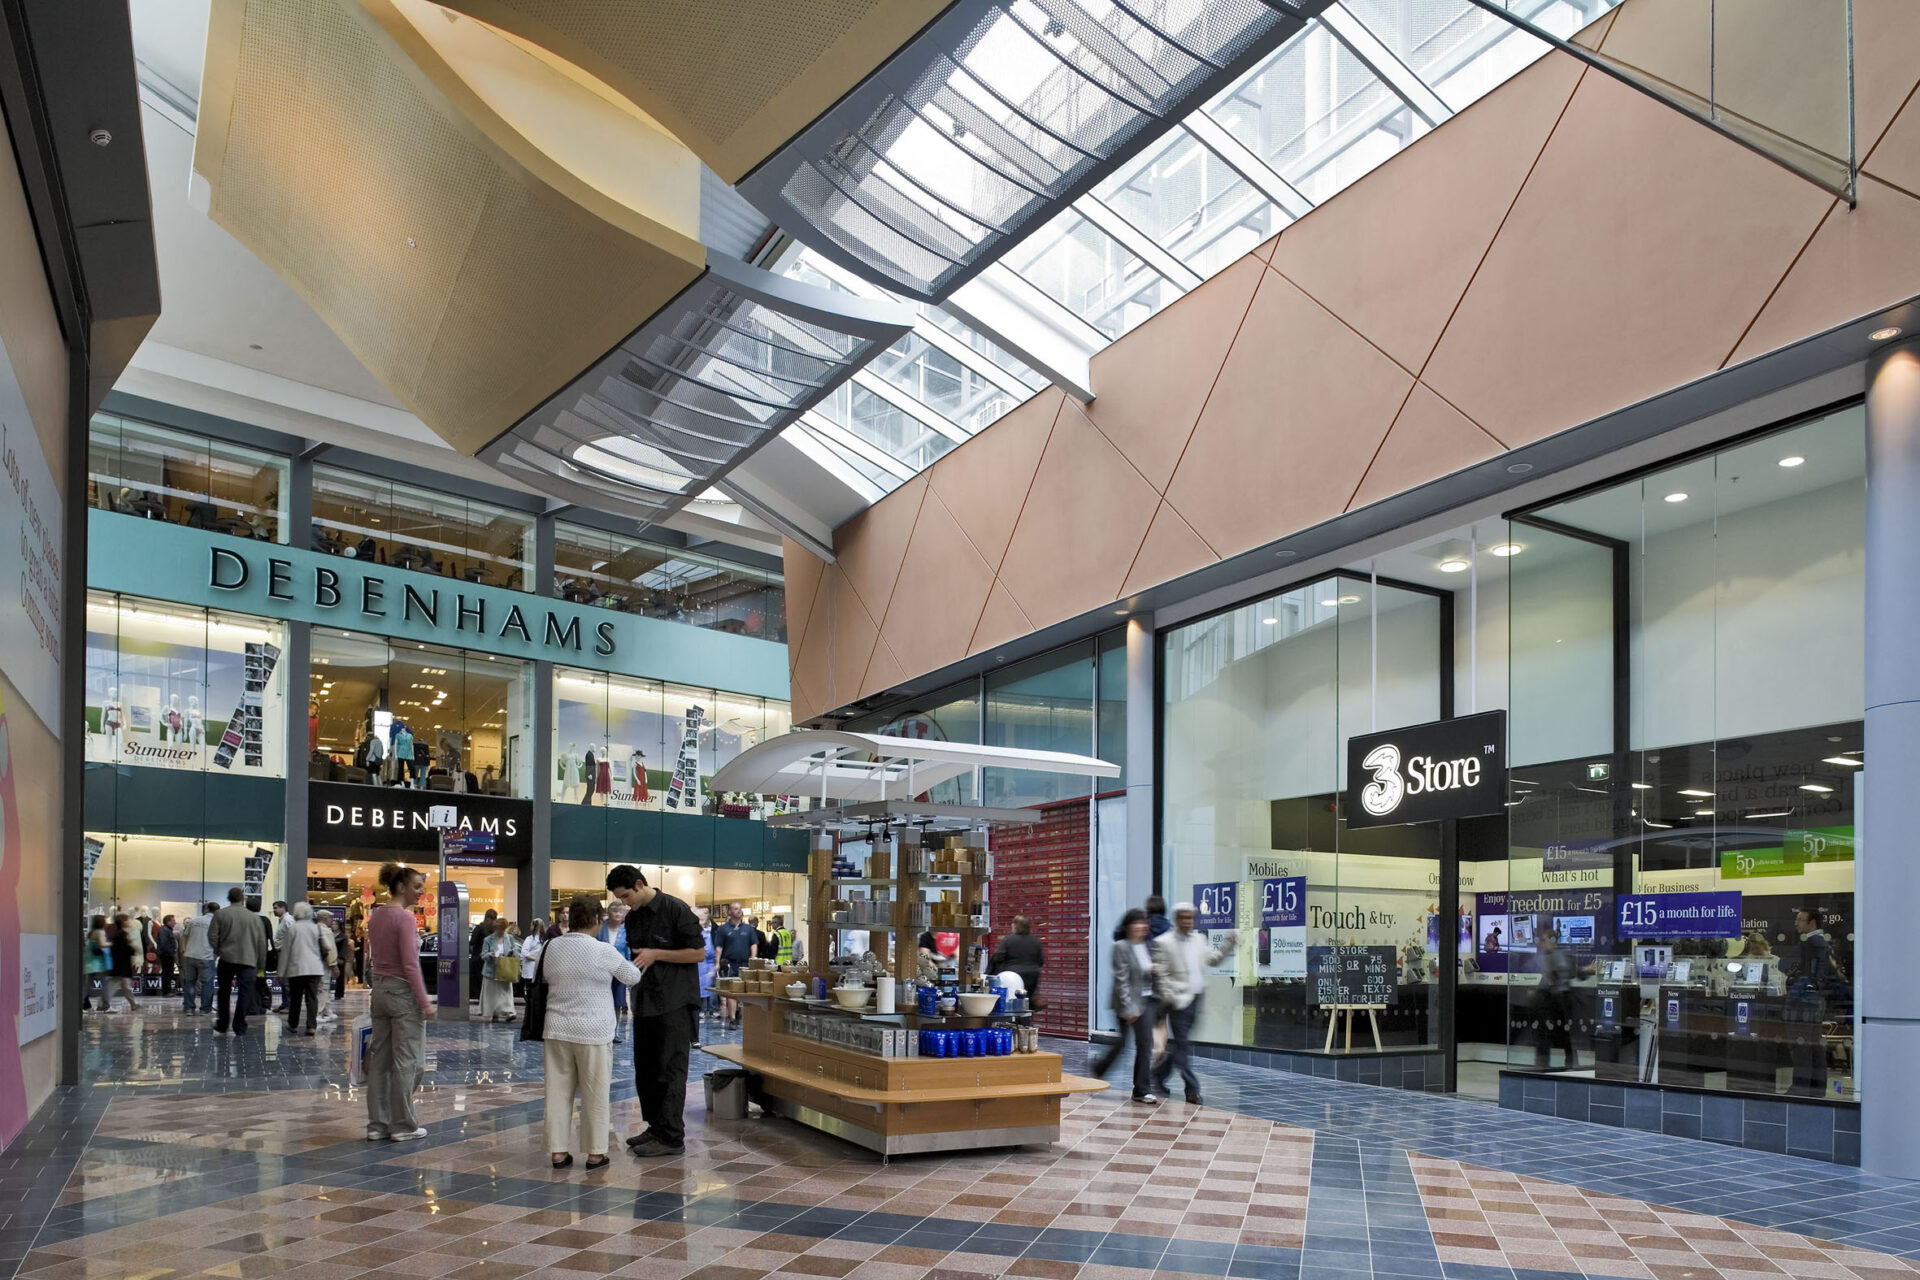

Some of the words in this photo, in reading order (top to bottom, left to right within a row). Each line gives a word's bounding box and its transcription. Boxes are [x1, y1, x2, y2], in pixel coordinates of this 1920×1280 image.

[208, 546, 617, 657] DEBENHAMS
[124, 741, 197, 760] Summer
[1361, 744, 1405, 816] 3
[1406, 755, 1481, 795] Store
[326, 804, 517, 837] DEBENAMS
[1546, 845, 1567, 860] £15
[1803, 834, 1826, 858] 5p
[1248, 862, 1289, 877] Mobiles
[1736, 854, 1755, 875] 5p
[1541, 869, 1577, 883] What's
[1580, 868, 1599, 881] hot
[316, 880, 322, 889] 2
[1643, 883, 1657, 894] for
[1658, 882, 1699, 893] Business
[1200, 886, 1232, 915] £15
[1261, 881, 1297, 912] £15
[1483, 894, 1506, 906] Enjoy
[1506, 894, 1564, 913] freedom
[1567, 899, 1581, 911] for
[1584, 893, 1602, 910] £5
[1265, 913, 1280, 922] month
[1280, 912, 1288, 921] for
[1310, 905, 1366, 930] Touch
[1369, 910, 1378, 924] &
[1379, 911, 1396, 928] try.
[1620, 901, 1657, 926] £15
[1659, 911, 1665, 919] a
[1666, 906, 1699, 919] month
[1701, 906, 1716, 918] for
[1717, 905, 1737, 918] life.
[1330, 947, 1336, 955] 3
[1340, 946, 1368, 955] STORE
[1322, 956, 1340, 964] 500
[1346, 960, 1360, 970] OR
[1370, 955, 1383, 964] 75
[1319, 964, 1343, 973] MINS
[1364, 964, 1387, 973] MINS
[1317, 977, 1341, 986] ONLY
[1367, 975, 1384, 984] 600
[1362, 984, 1392, 993] TEXTS
[1318, 994, 1349, 1003] MONTH
[1351, 994, 1367, 1003] FOR
[1368, 994, 1389, 1004] LIFE
[1730, 992, 1756, 1000] Exclusive
